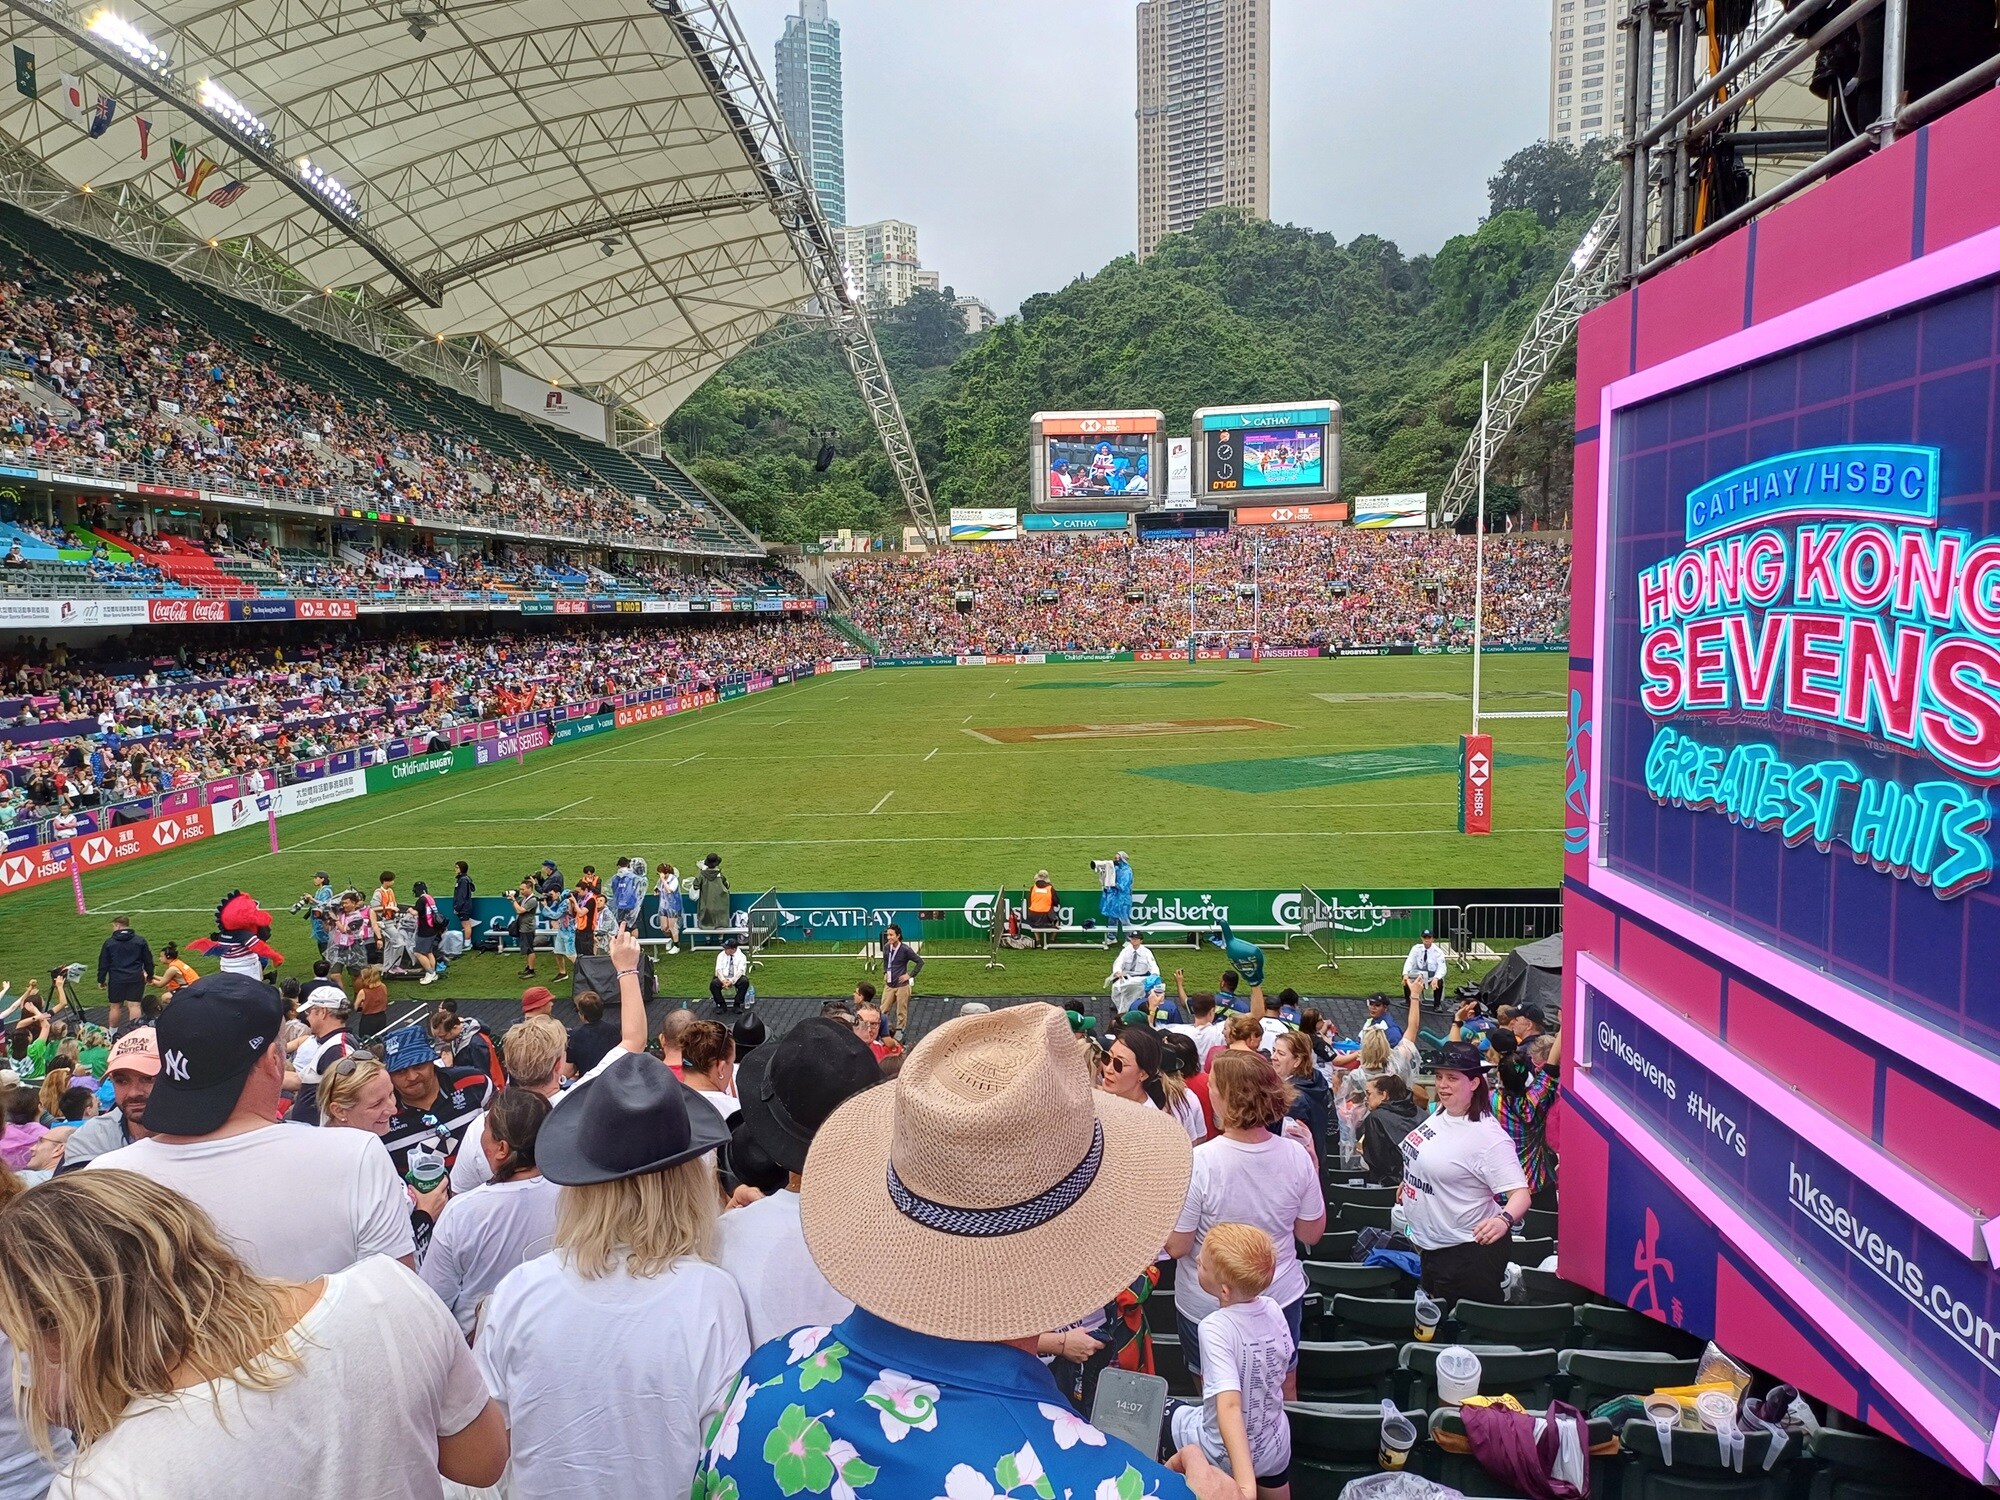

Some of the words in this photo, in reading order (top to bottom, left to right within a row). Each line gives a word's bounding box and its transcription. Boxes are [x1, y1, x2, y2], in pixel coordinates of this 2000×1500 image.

[1254, 416, 1290, 426] CATHAY
[1692, 460, 1926, 527] CATHAY/HSBC
[1063, 520, 1099, 528] CATHAY
[1638, 529, 1786, 629] HONG
[1340, 648, 1379, 656] RUGBYPASS
[1640, 612, 2000, 777] SEVENS
[392, 760, 430, 779] ChildFund
[1474, 788, 1484, 817] HSBC
[1646, 728, 1860, 844] GREATEST
[1851, 778, 1993, 890] HITS
[182, 825, 205, 841] HSBC
[115, 842, 140, 858] HSBC
[37, 860, 67, 878] HSBC
[808, 911, 897, 927] CATHAY
[1271, 893, 1387, 927] Carlsberg
[164, 1048, 191, 1082] NY
[1597, 1020, 1677, 1101] @hksevens
[1686, 1090, 1747, 1157] #HK7s
[1788, 1161, 2000, 1360] hksevens.com
[1115, 1399, 1143, 1413] 14:07
